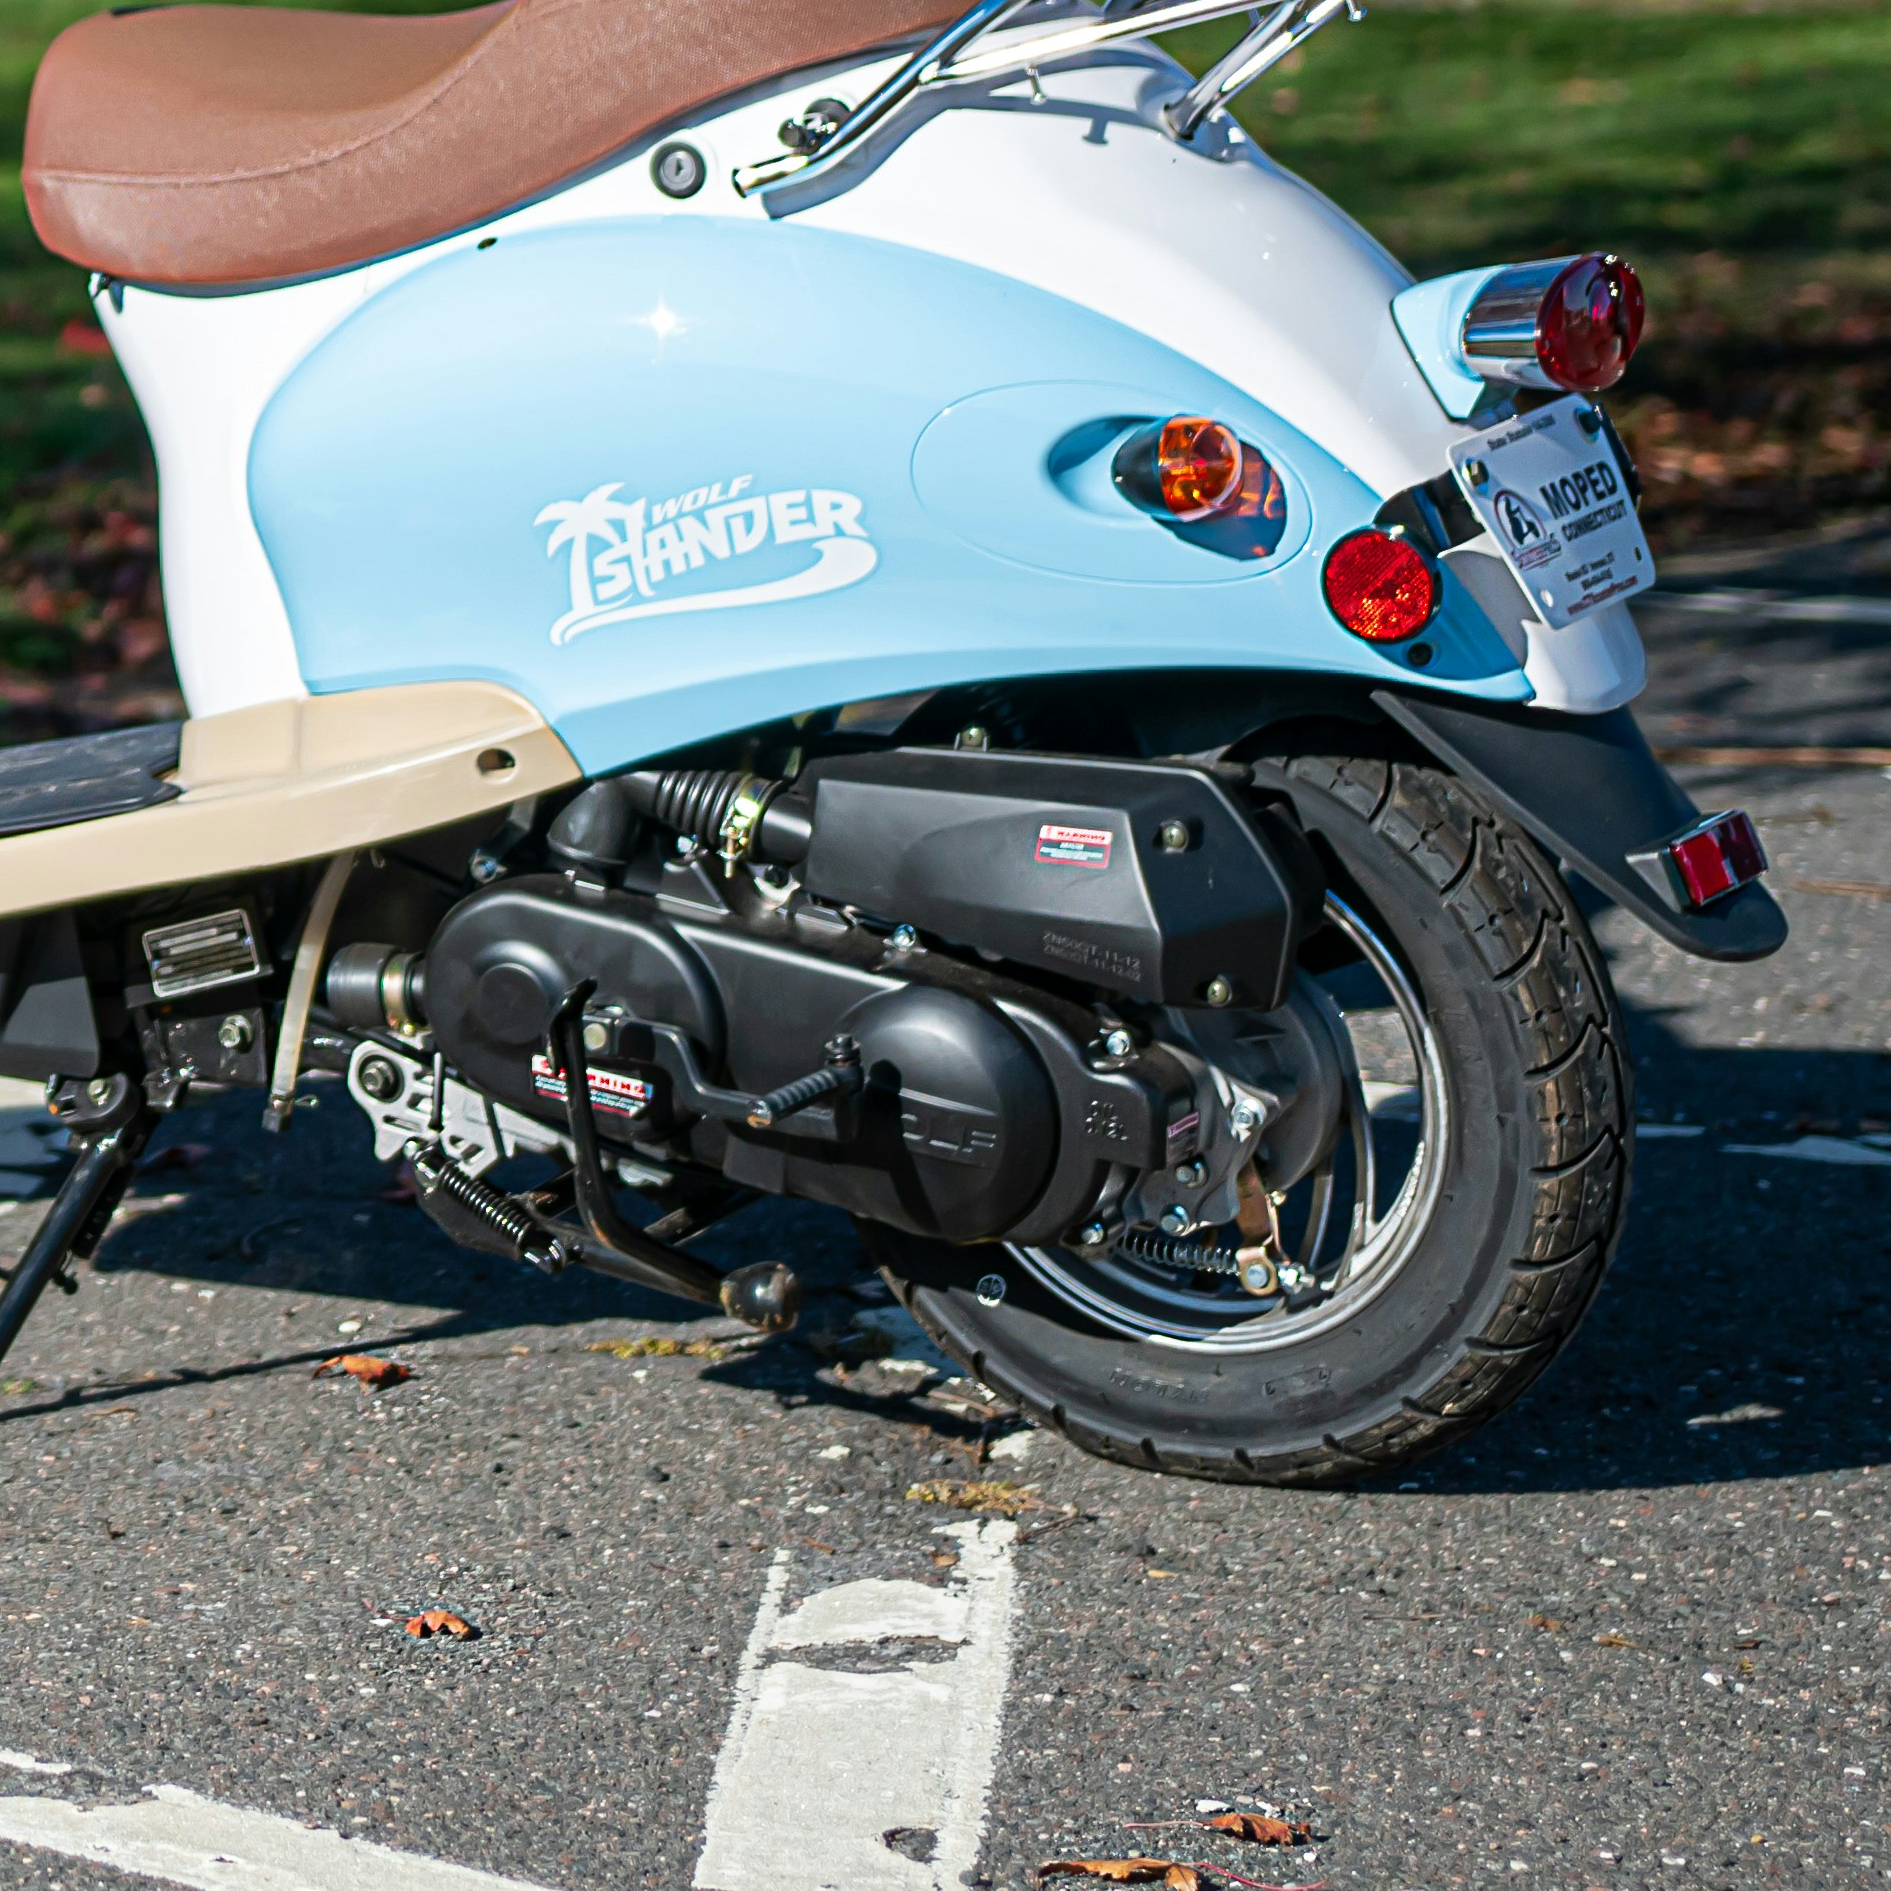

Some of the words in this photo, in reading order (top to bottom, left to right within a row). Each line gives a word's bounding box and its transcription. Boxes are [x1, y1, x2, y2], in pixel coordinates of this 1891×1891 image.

[651, 473, 754, 525] WOLF
[1539, 460, 1618, 520] MOPED
[1561, 499, 1628, 542] CONNECTICUT
